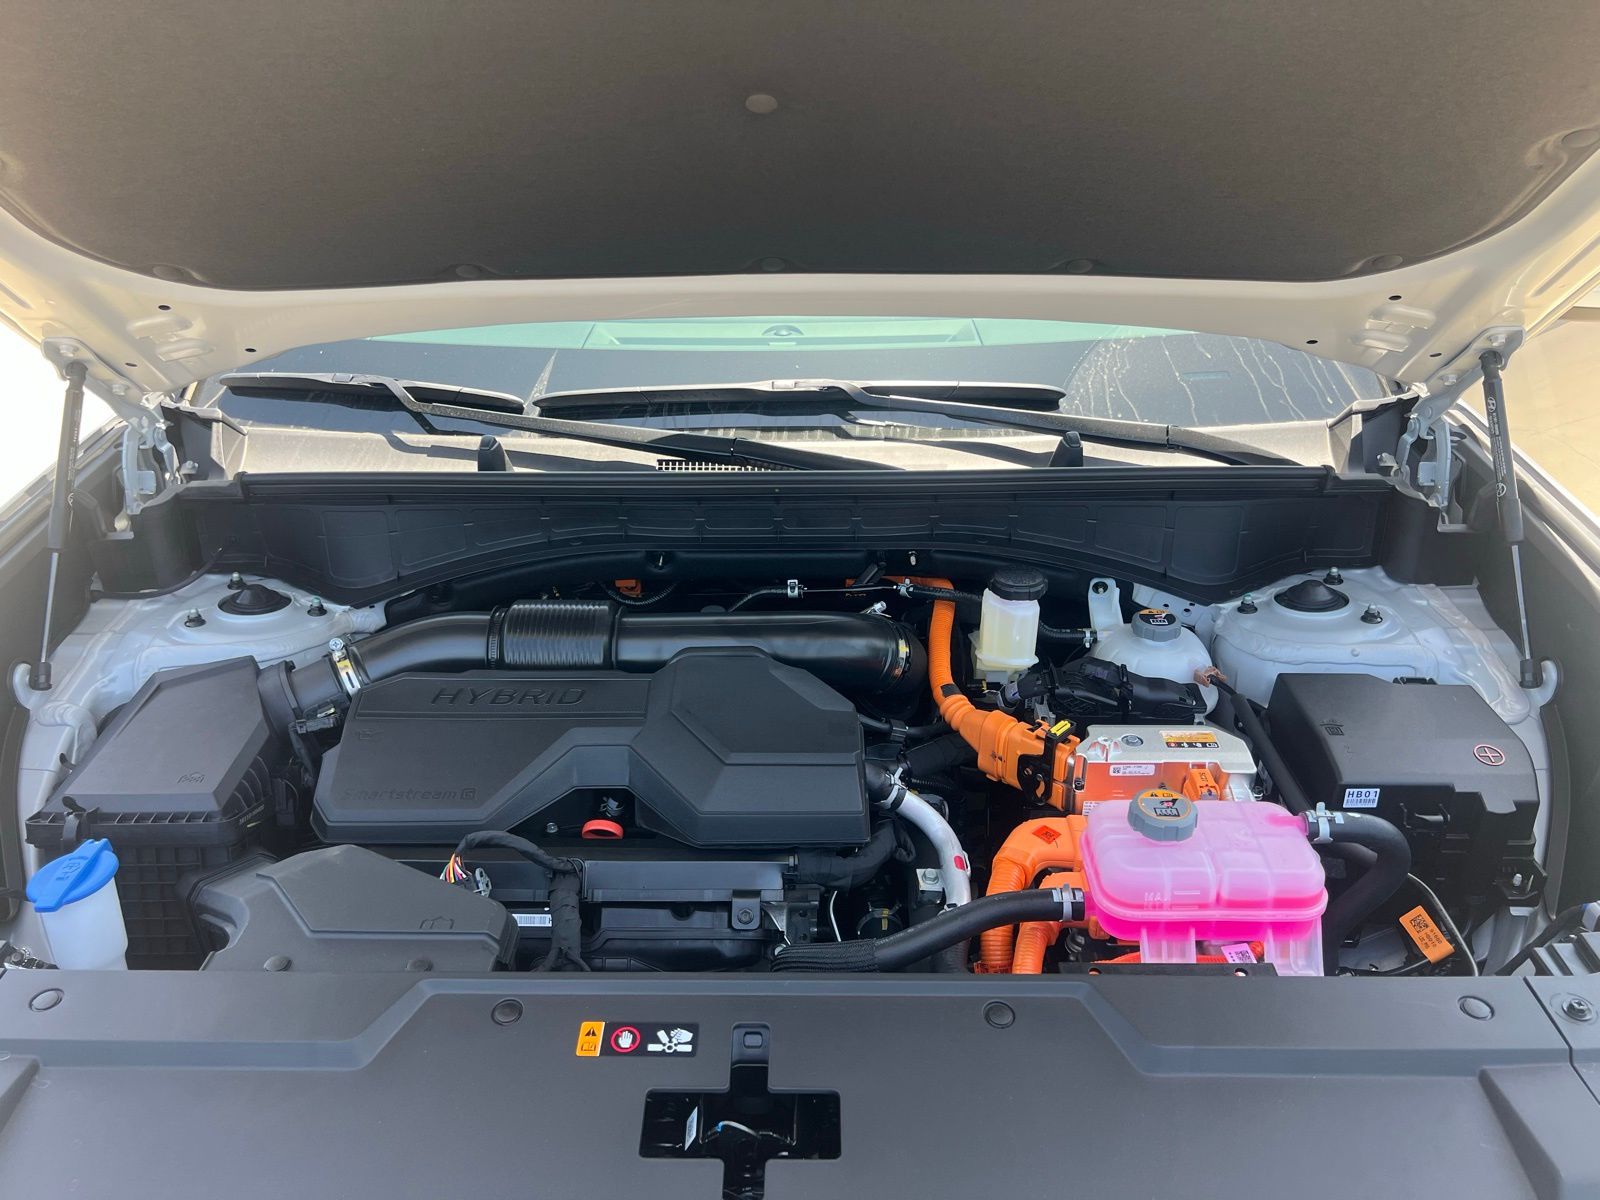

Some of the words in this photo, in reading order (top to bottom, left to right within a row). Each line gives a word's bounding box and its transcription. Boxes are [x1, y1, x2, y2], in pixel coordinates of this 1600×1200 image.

[431, 687, 586, 706] HYBRID
[344, 787, 461, 801] Smartstream
[1347, 790, 1378, 798] HB01
